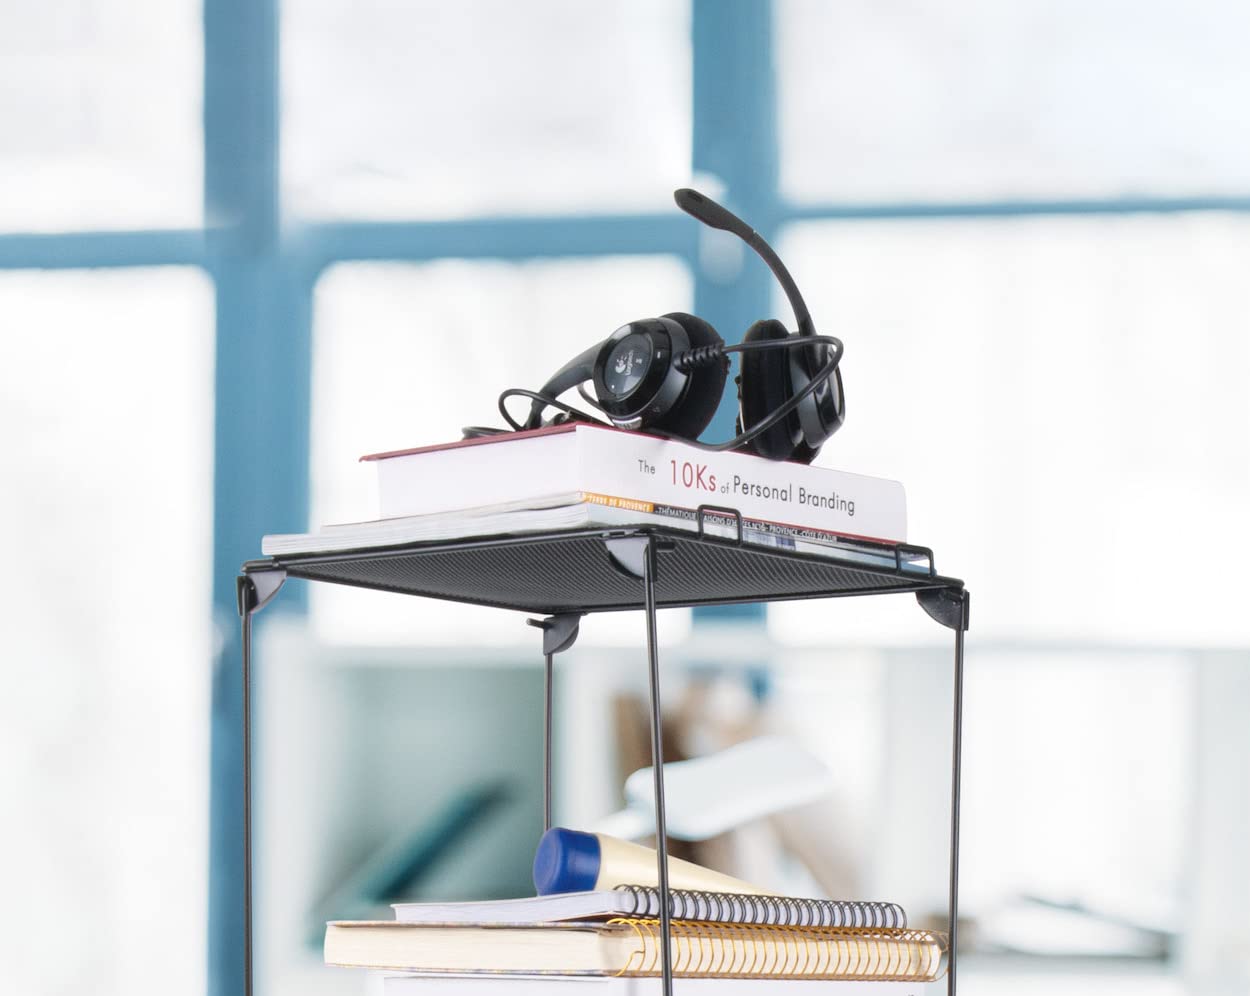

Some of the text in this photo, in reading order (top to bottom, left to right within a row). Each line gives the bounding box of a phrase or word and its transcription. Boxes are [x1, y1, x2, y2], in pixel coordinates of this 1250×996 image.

[638, 459, 855, 517] The 10Ks of Personal Branding
[700, 513, 725, 526] AISONS
